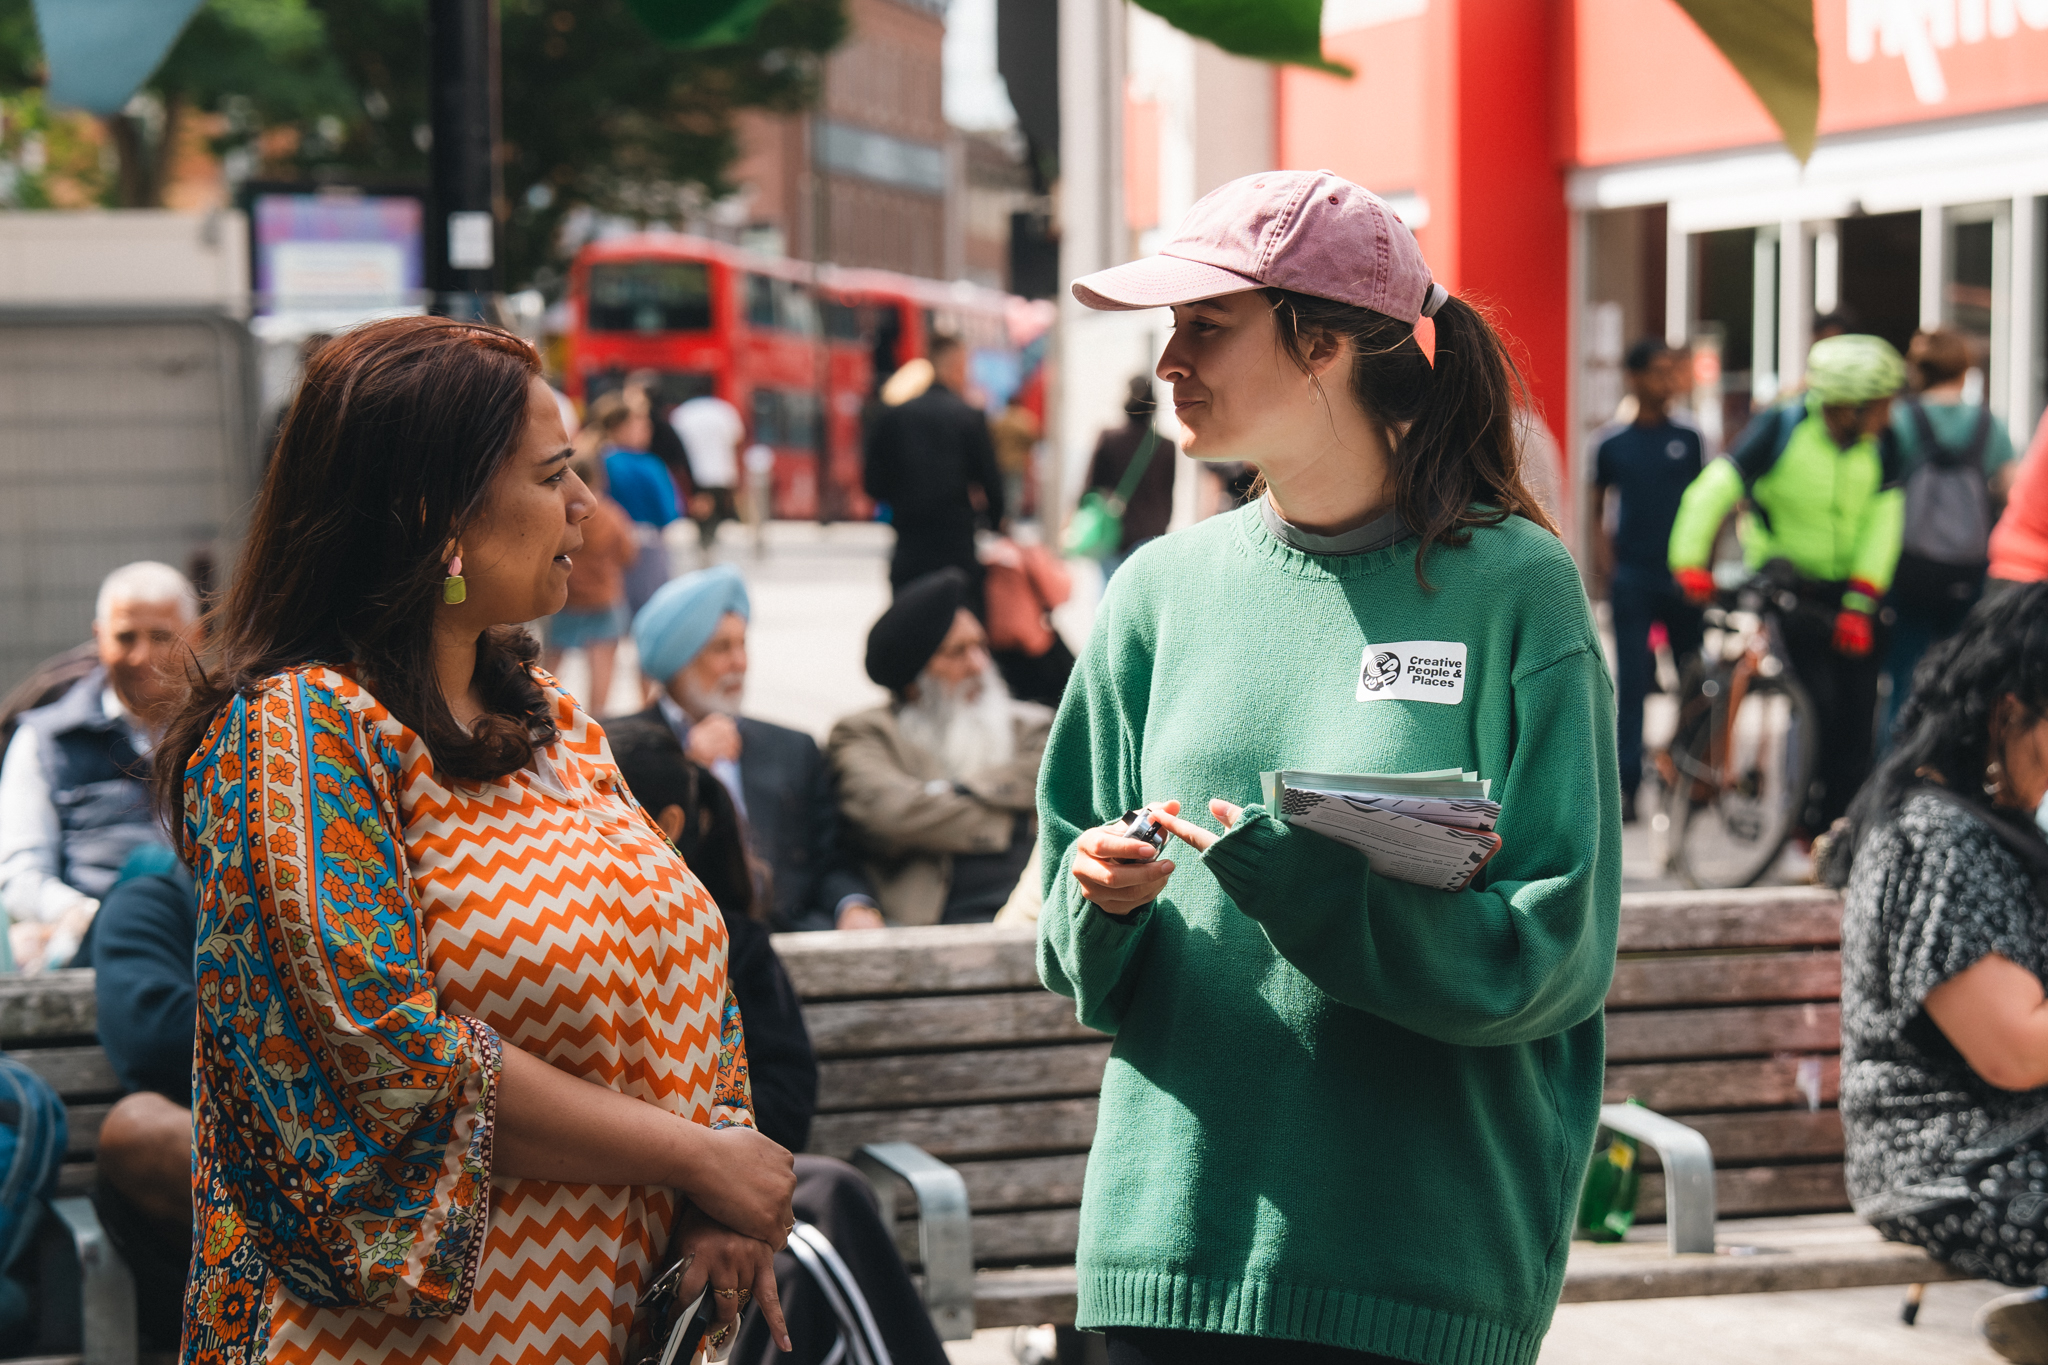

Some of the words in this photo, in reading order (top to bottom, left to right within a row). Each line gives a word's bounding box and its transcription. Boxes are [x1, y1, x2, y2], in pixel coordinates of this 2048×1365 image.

[1410, 656, 1462, 668] Creative
[1407, 666, 1450, 678] People
[1453, 669, 1462, 678] &
[1412, 675, 1455, 687] Places
